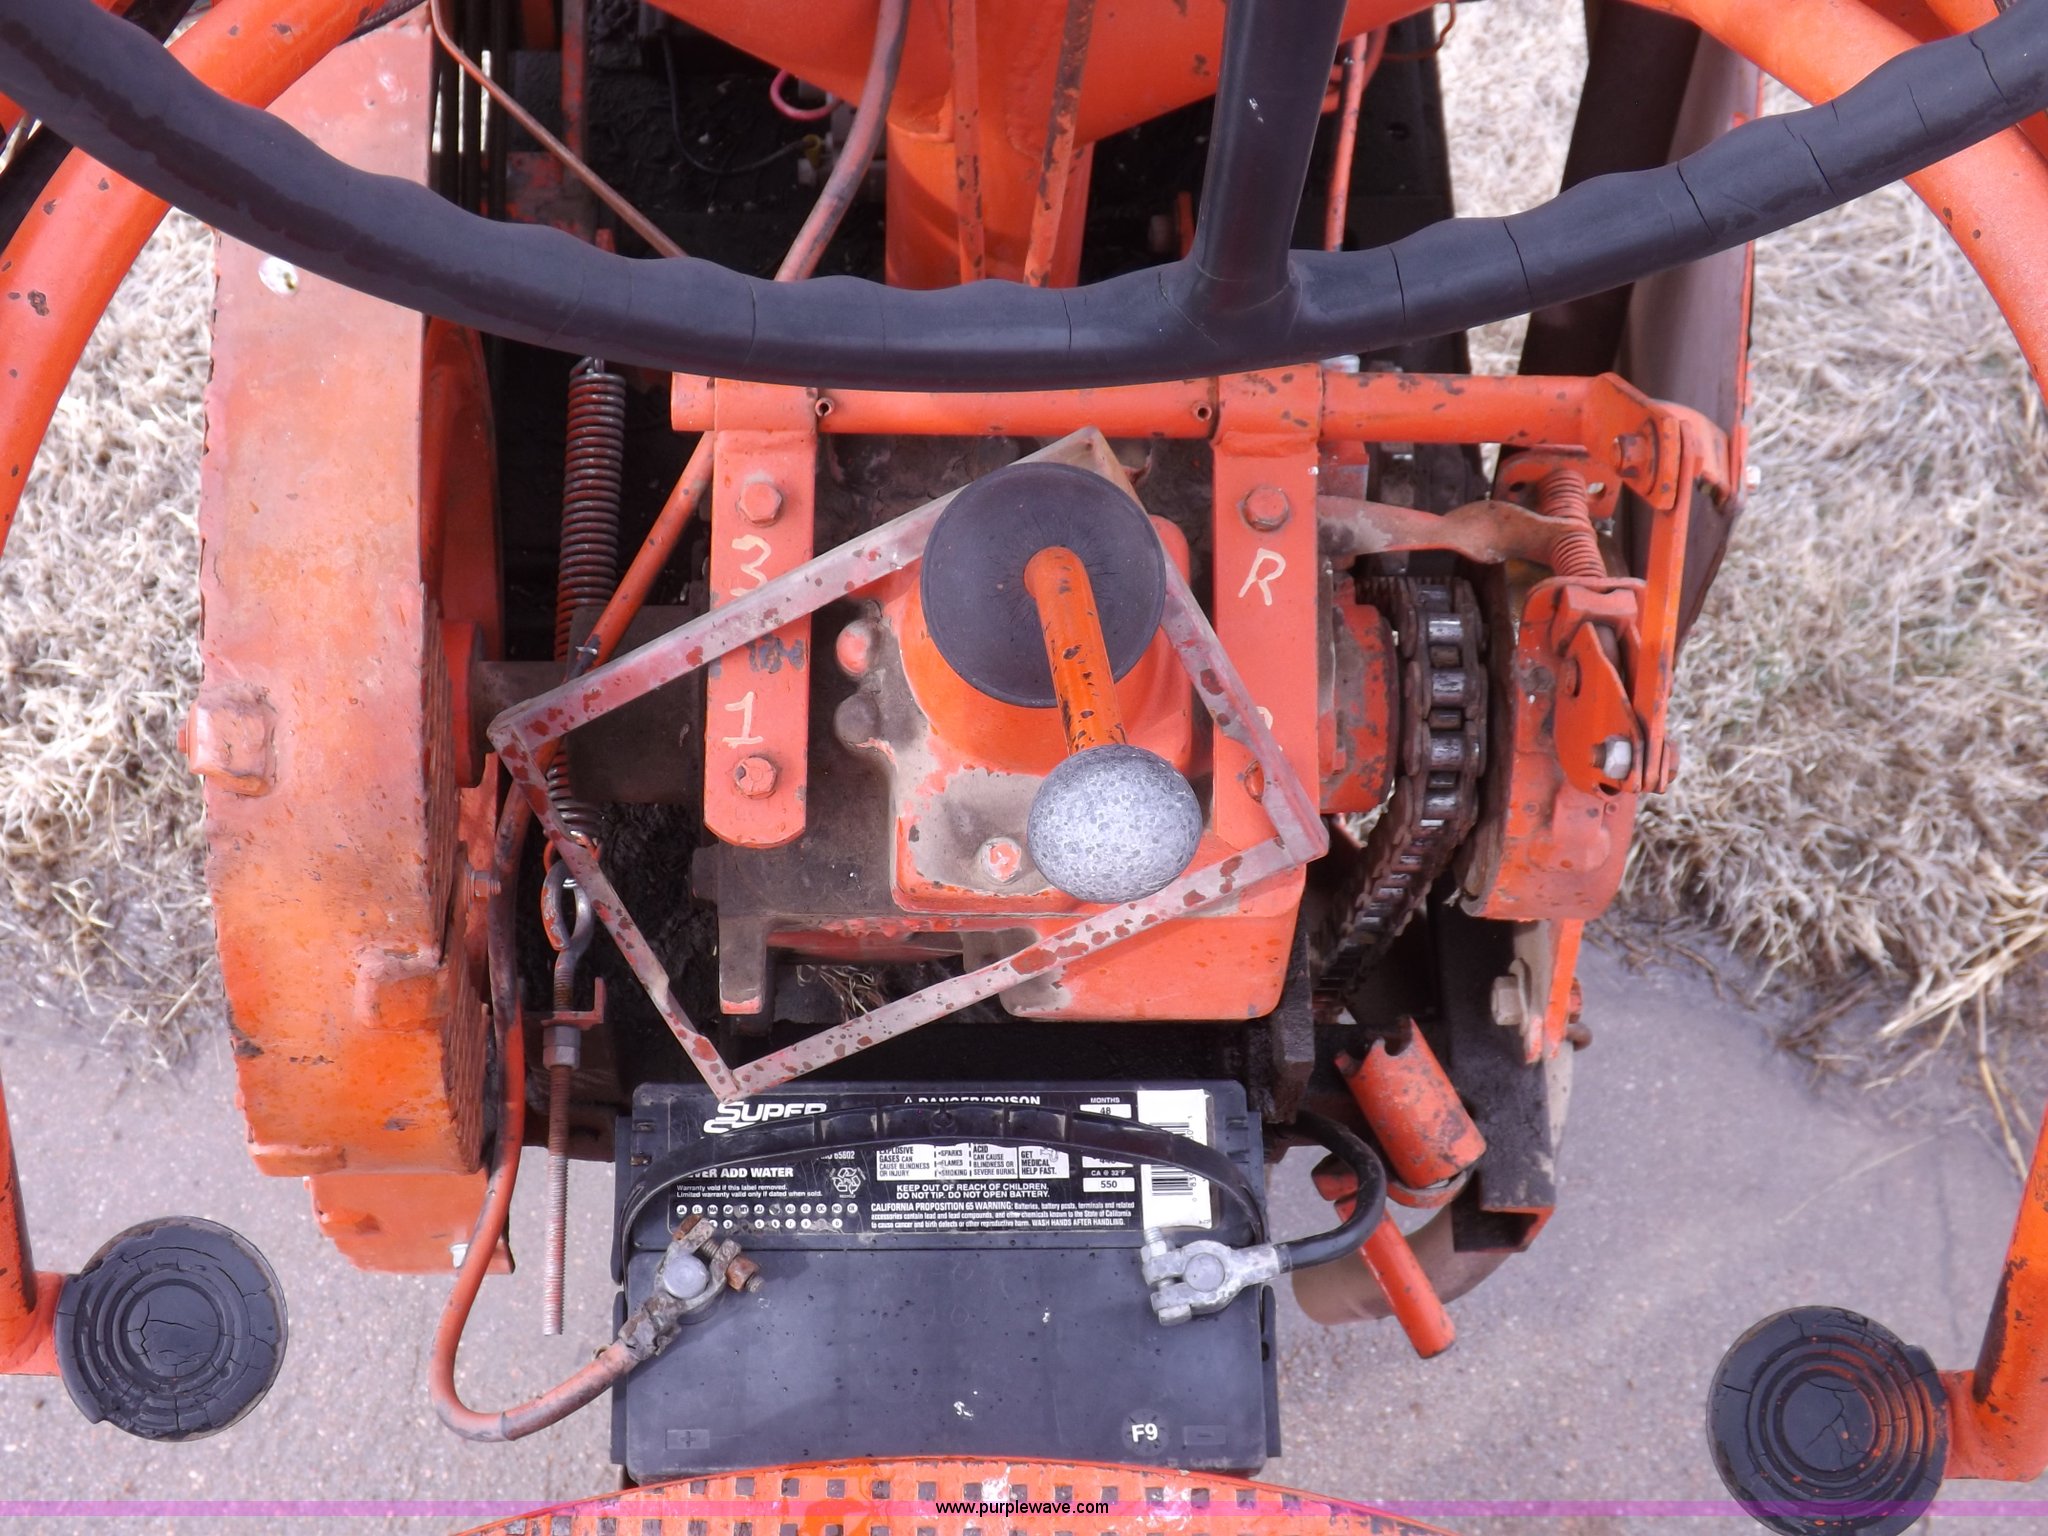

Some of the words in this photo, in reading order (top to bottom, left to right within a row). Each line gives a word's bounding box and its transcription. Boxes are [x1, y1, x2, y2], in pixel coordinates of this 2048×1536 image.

[731, 534, 772, 597] 3
[1238, 548, 1286, 606] R
[722, 691, 764, 748] 1
[1100, 1107, 1111, 1115] 48
[973, 1145, 988, 1153] ACID
[1021, 1151, 1033, 1159] GET
[1021, 1159, 1050, 1167] MEDICAL
[720, 1168, 748, 1178] ADD
[750, 1167, 794, 1178] WATER
[1021, 1167, 1038, 1175] HELP
[1040, 1167, 1057, 1175] FAST.
[896, 1184, 920, 1192] KEEP
[922, 1184, 940, 1192] OUT
[956, 1183, 987, 1191] REACH
[988, 1183, 1000, 1191] OF
[1002, 1183, 1049, 1191] CHILDREN.
[1100, 1180, 1118, 1188] 550
[702, 1191, 730, 1199] warranty
[747, 1191, 761, 1199] only
[896, 1191, 909, 1200] DO
[911, 1191, 929, 1199] NOT
[930, 1191, 945, 1199] TIP.
[948, 1191, 961, 1199] DO
[963, 1191, 981, 1199] NOT
[1009, 1190, 1050, 1198] BATTERY.
[871, 1202, 914, 1212] CALIFORNIA
[915, 1202, 964, 1211] PROPOSITION
[965, 1201, 974, 1210] 65
[975, 1201, 1013, 1210] WARNING:
[1041, 1202, 1059, 1211] battery
[1116, 1201, 1134, 1209] related
[903, 1212, 923, 1220] contain
[924, 1212, 936, 1220] lead
[995, 1211, 1005, 1219] and
[1006, 1211, 1020, 1219] other
[1021, 1210, 1048, 1218] chemicals
[1050, 1210, 1067, 1218] known
[1105, 1209, 1131, 1217] California
[938, 1220, 957, 1228] defects
[981, 1220, 1013, 1228] reproductive
[1073, 1218, 1091, 1226] AFTER
[1093, 1218, 1125, 1226] HANDLING.
[1131, 1423, 1158, 1442] F9
